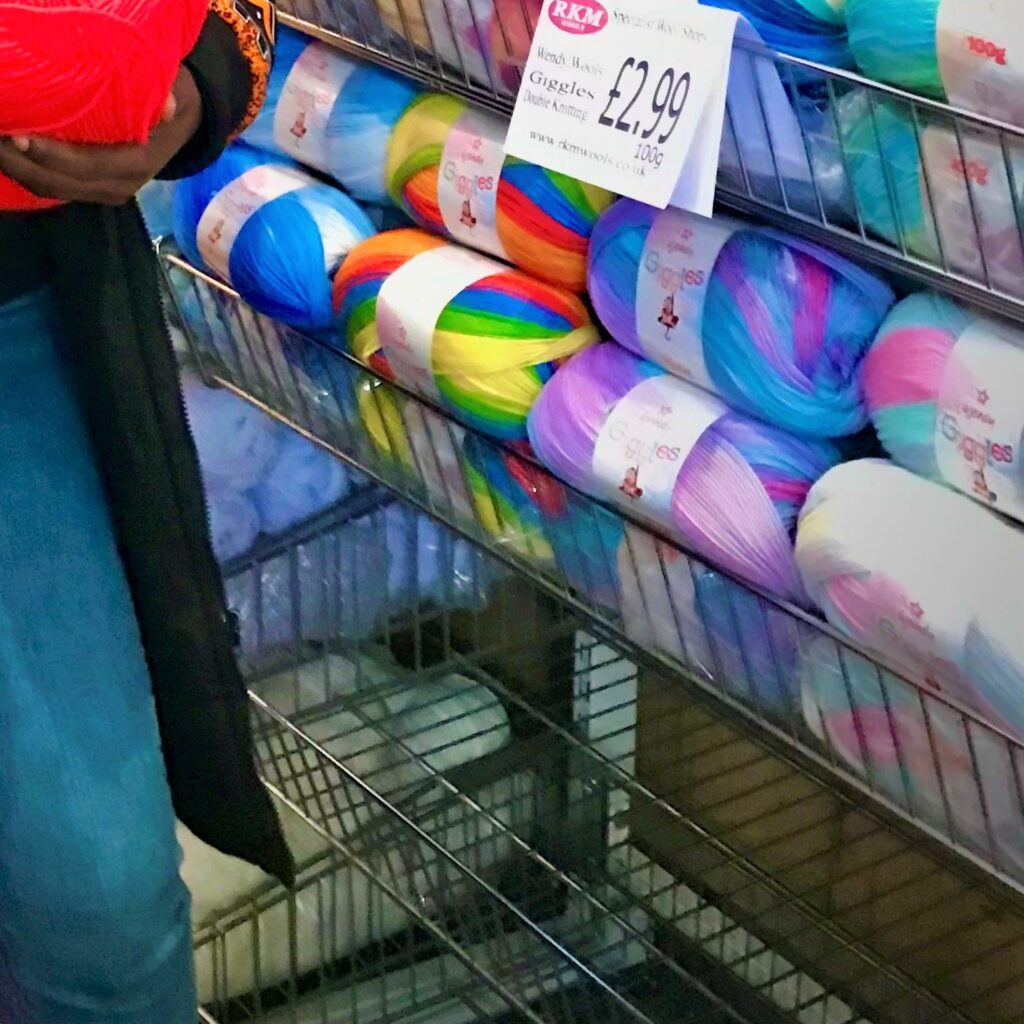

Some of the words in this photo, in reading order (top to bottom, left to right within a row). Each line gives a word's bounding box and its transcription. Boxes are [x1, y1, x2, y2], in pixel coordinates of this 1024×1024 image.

[537, 46, 567, 69] Wendy
[529, 70, 596, 101] Giggles
[598, 56, 691, 145] £2.99
[633, 143, 665, 170] 100g
[608, 420, 681, 464] Gggles
